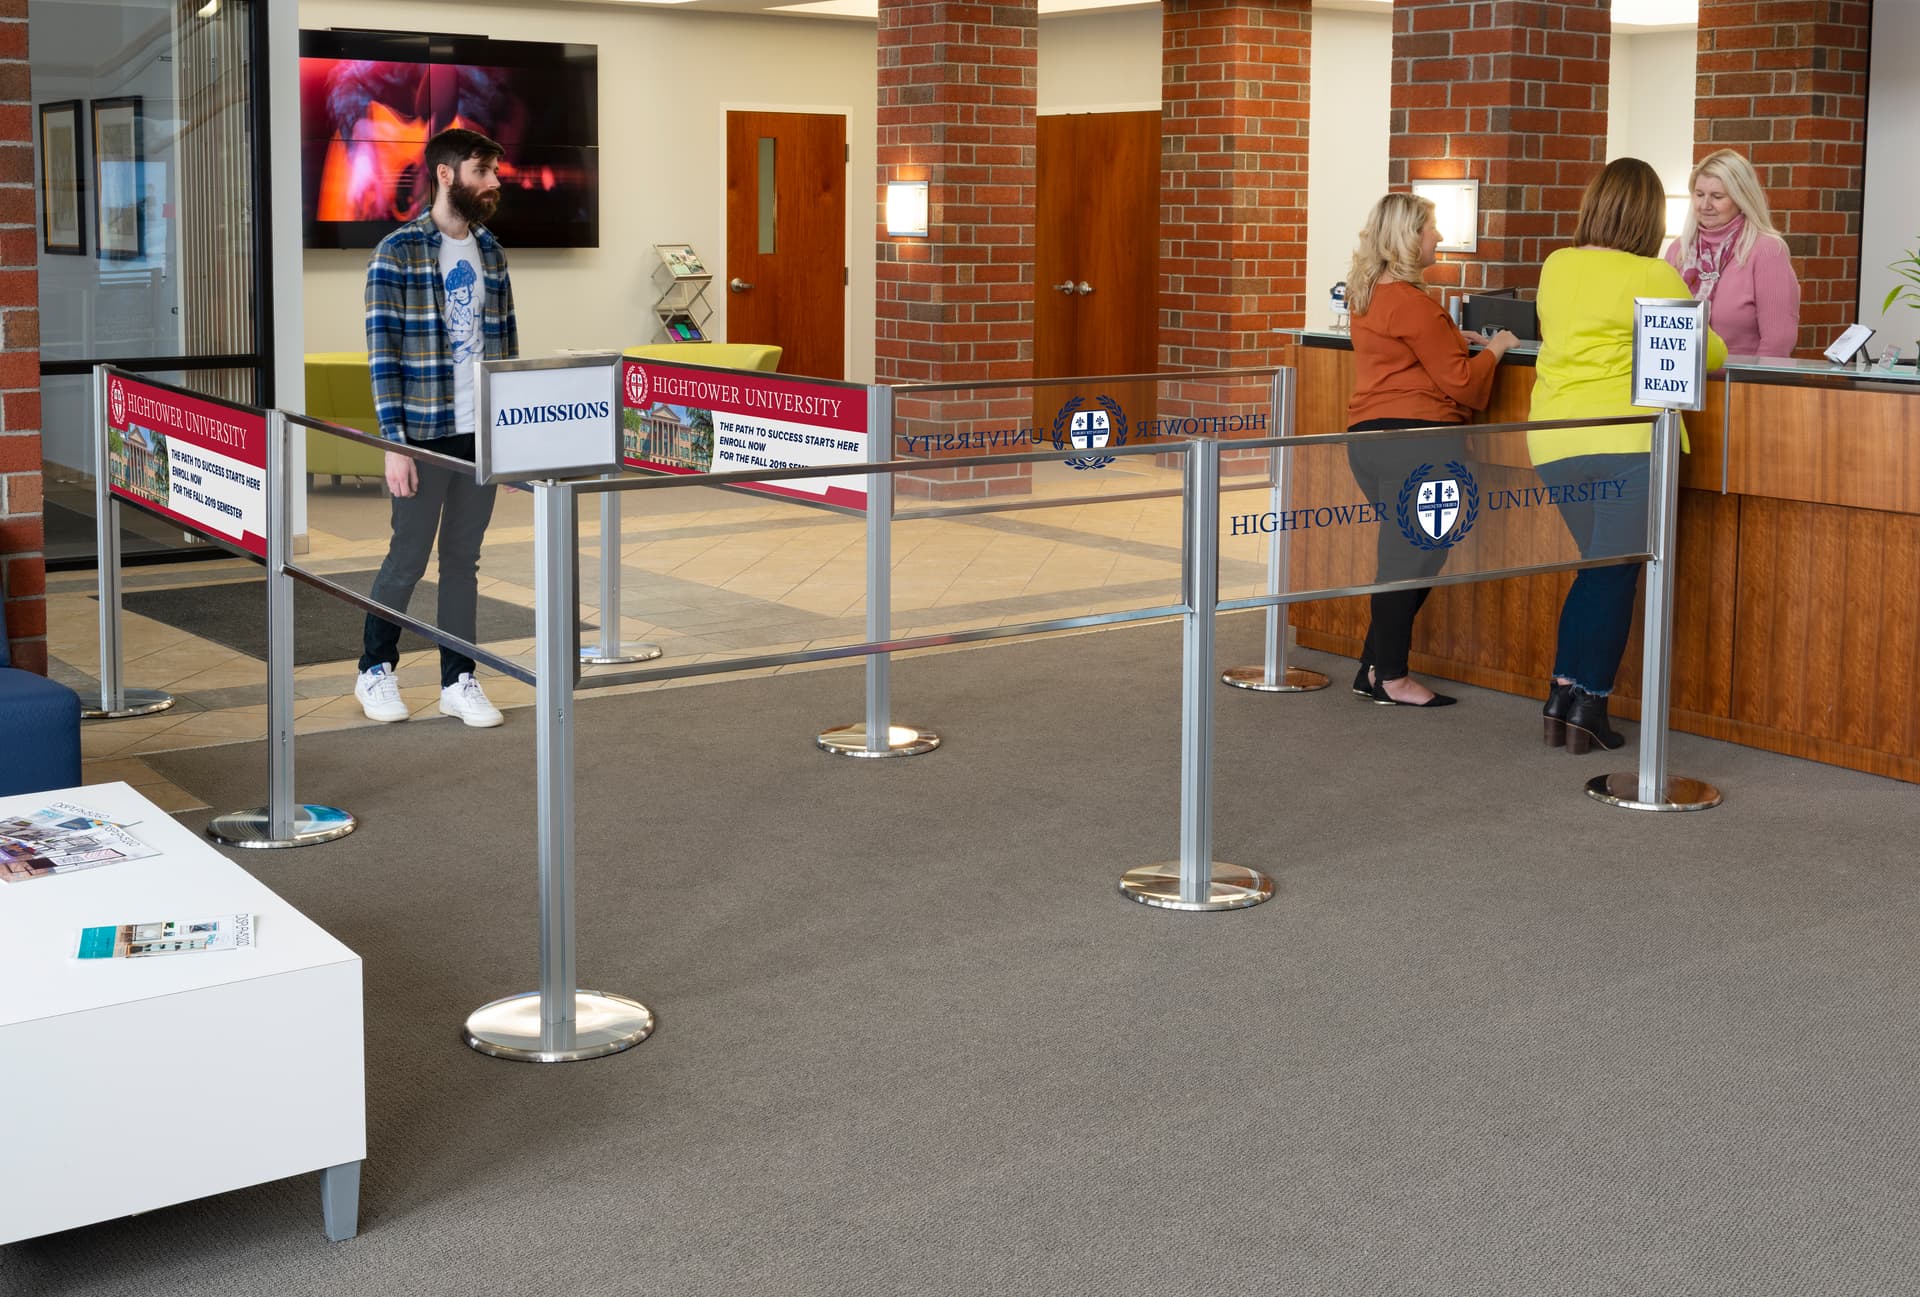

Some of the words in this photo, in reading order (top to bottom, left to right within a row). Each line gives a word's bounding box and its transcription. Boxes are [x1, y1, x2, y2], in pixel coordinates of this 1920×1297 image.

[1644, 315, 1694, 330] PLEASE
[1650, 336, 1687, 351] HAVE
[1660, 358, 1675, 371] ID
[1644, 377, 1689, 393] READY
[653, 376, 741, 405] HIGHTOWER
[745, 388, 842, 418] UNIVERSITY
[127, 392, 183, 429] HIGHTOWER
[185, 410, 247, 449] UNIVERSITY
[495, 401, 610, 427] ADMISSIONS
[719, 421, 734, 432] THE
[735, 424, 755, 436] PATH
[756, 427, 767, 437] TO
[768, 429, 804, 443] SUCCESS
[805, 435, 836, 449] STARTS
[837, 440, 860, 452] HERE
[719, 436, 746, 449] ENROLL
[748, 441, 767, 452] NOW
[171, 449, 180, 461] THE
[181, 452, 194, 466] PATH
[194, 457, 201, 469] TO
[202, 460, 225, 478] SUCCESS
[225, 469, 245, 486] STARTS
[245, 476, 261, 491] HERE
[719, 450, 734, 462] FOR
[736, 453, 750, 464] THE
[750, 456, 768, 467] FALL
[769, 459, 787, 469] 2019
[172, 466, 190, 481] ENROLL
[190, 472, 203, 487] NOW
[173, 482, 183, 495] FOR
[183, 487, 193, 500] THE
[193, 490, 204, 504] FALL
[204, 495, 216, 509] 2019
[217, 500, 243, 520] SEMESTER
[1230, 501, 1389, 537] HIGHTOWER
[1488, 478, 1628, 512] UNIVERSITY
